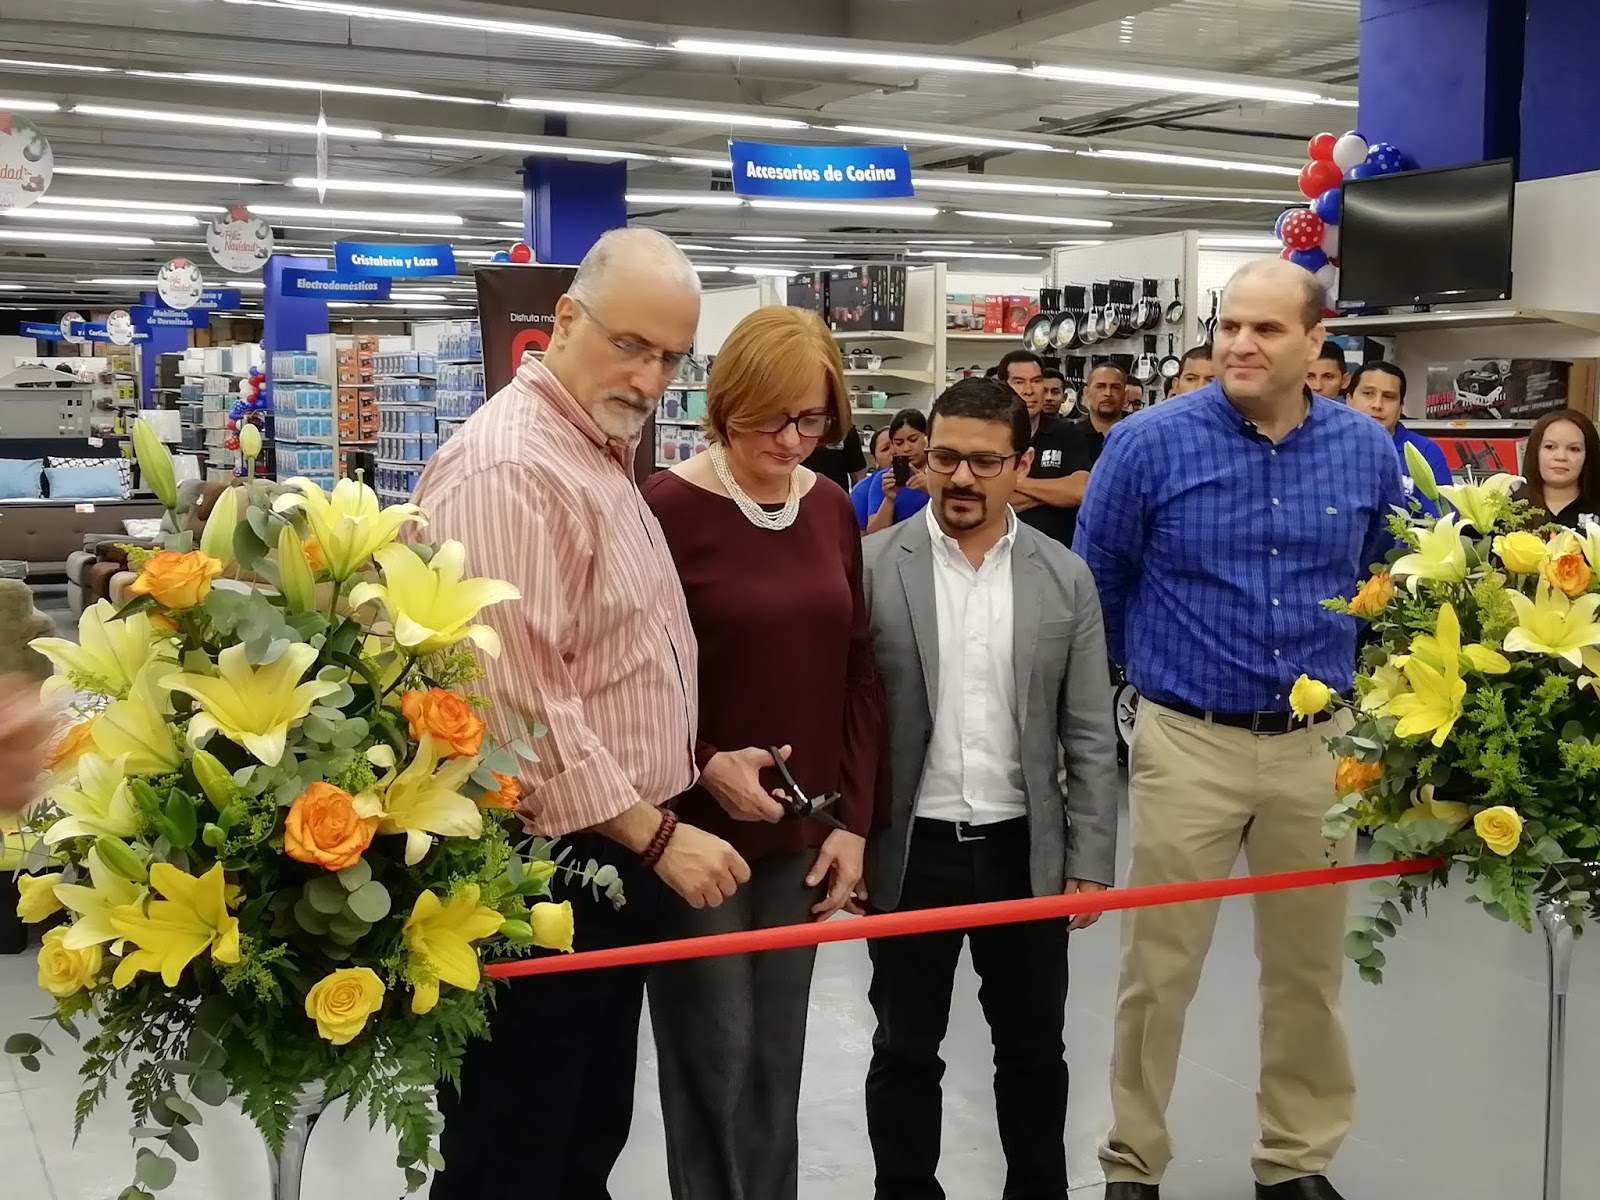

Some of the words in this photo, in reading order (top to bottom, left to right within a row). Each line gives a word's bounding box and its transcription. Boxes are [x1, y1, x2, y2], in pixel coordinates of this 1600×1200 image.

[746, 160, 820, 182] Accesorios
[824, 164, 843, 182] de
[846, 163, 896, 182] Cocina
[224, 241, 256, 252] Navidad
[351, 254, 403, 267] Cristalería
[405, 257, 412, 268] y
[413, 256, 438, 267] Loza
[296, 278, 379, 291] Electrodomésticos
[152, 309, 188, 318] Mobiliario
[510, 312, 540, 323] Disfruta
[541, 313, 556, 323] má
[146, 316, 157, 325] de
[157, 317, 194, 326] Dormitorio
